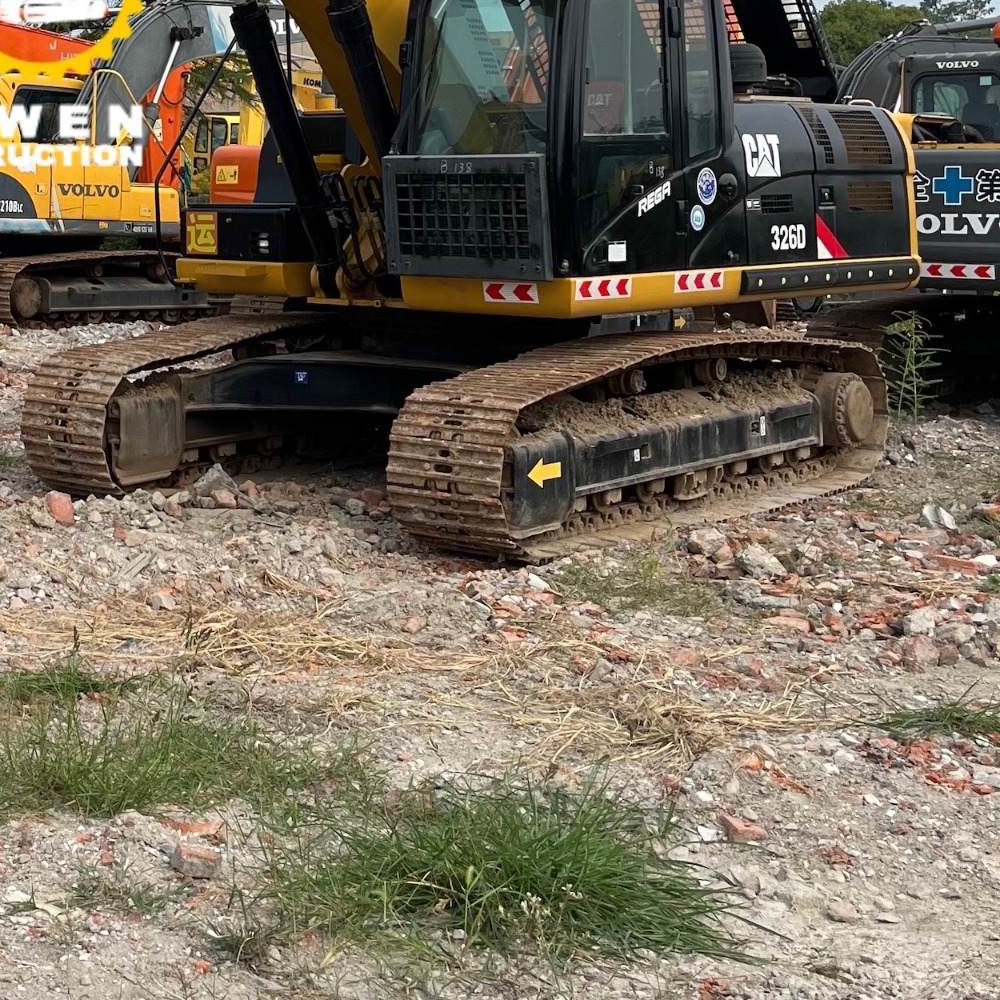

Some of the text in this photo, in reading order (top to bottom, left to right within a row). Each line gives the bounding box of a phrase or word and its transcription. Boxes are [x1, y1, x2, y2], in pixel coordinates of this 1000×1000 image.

[936, 60, 979, 69] VOLVO
[741, 133, 781, 178] CAT
[57, 183, 120, 198] VOLVO
[637, 180, 671, 217] REGA
[187, 213, 217, 253] 运
[771, 223, 806, 251] 326D
[916, 213, 1000, 234] OLV
